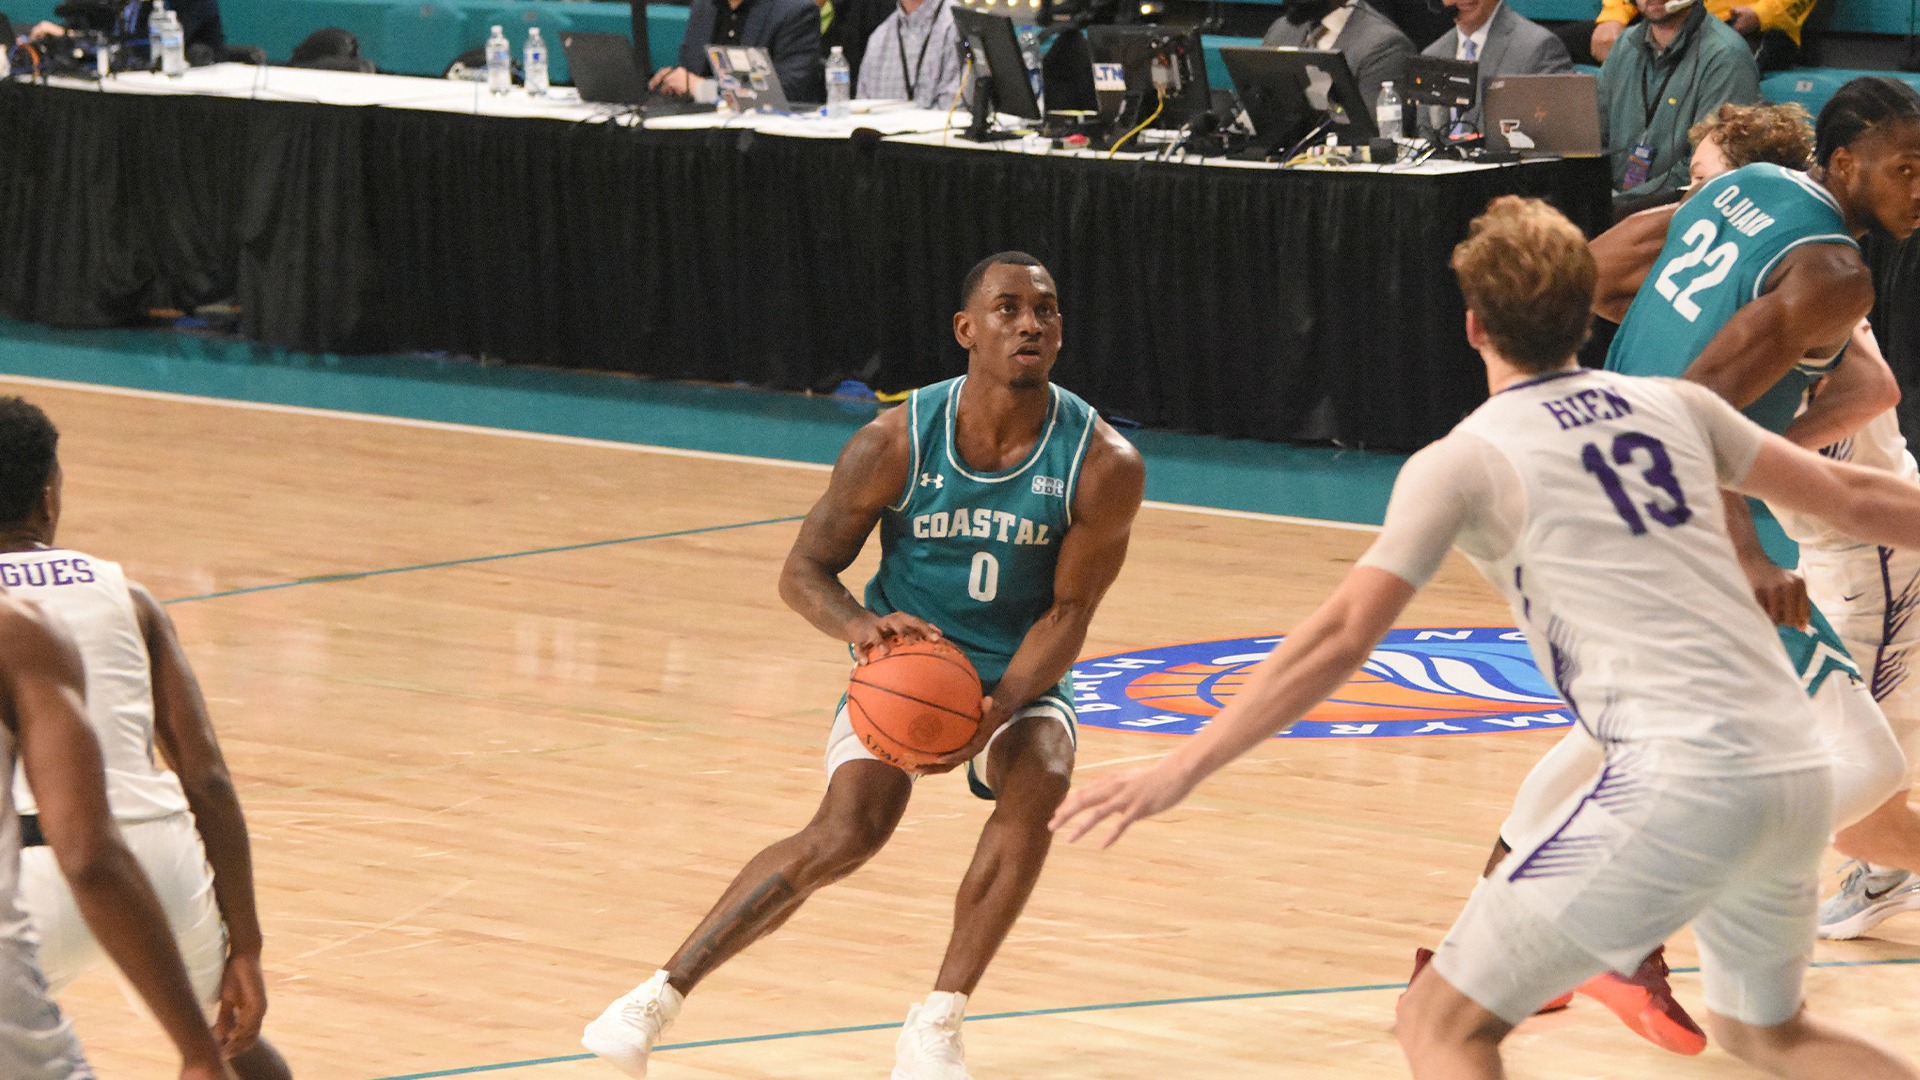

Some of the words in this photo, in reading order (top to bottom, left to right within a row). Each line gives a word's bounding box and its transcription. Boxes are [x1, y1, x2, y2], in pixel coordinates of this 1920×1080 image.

[1655, 219, 1739, 322] 22
[1541, 385, 1633, 430] HIEN
[1582, 431, 1692, 536] 13
[913, 508, 1050, 545] COASTAL
[0, 559, 95, 587] GUES
[968, 551, 999, 602] 0
